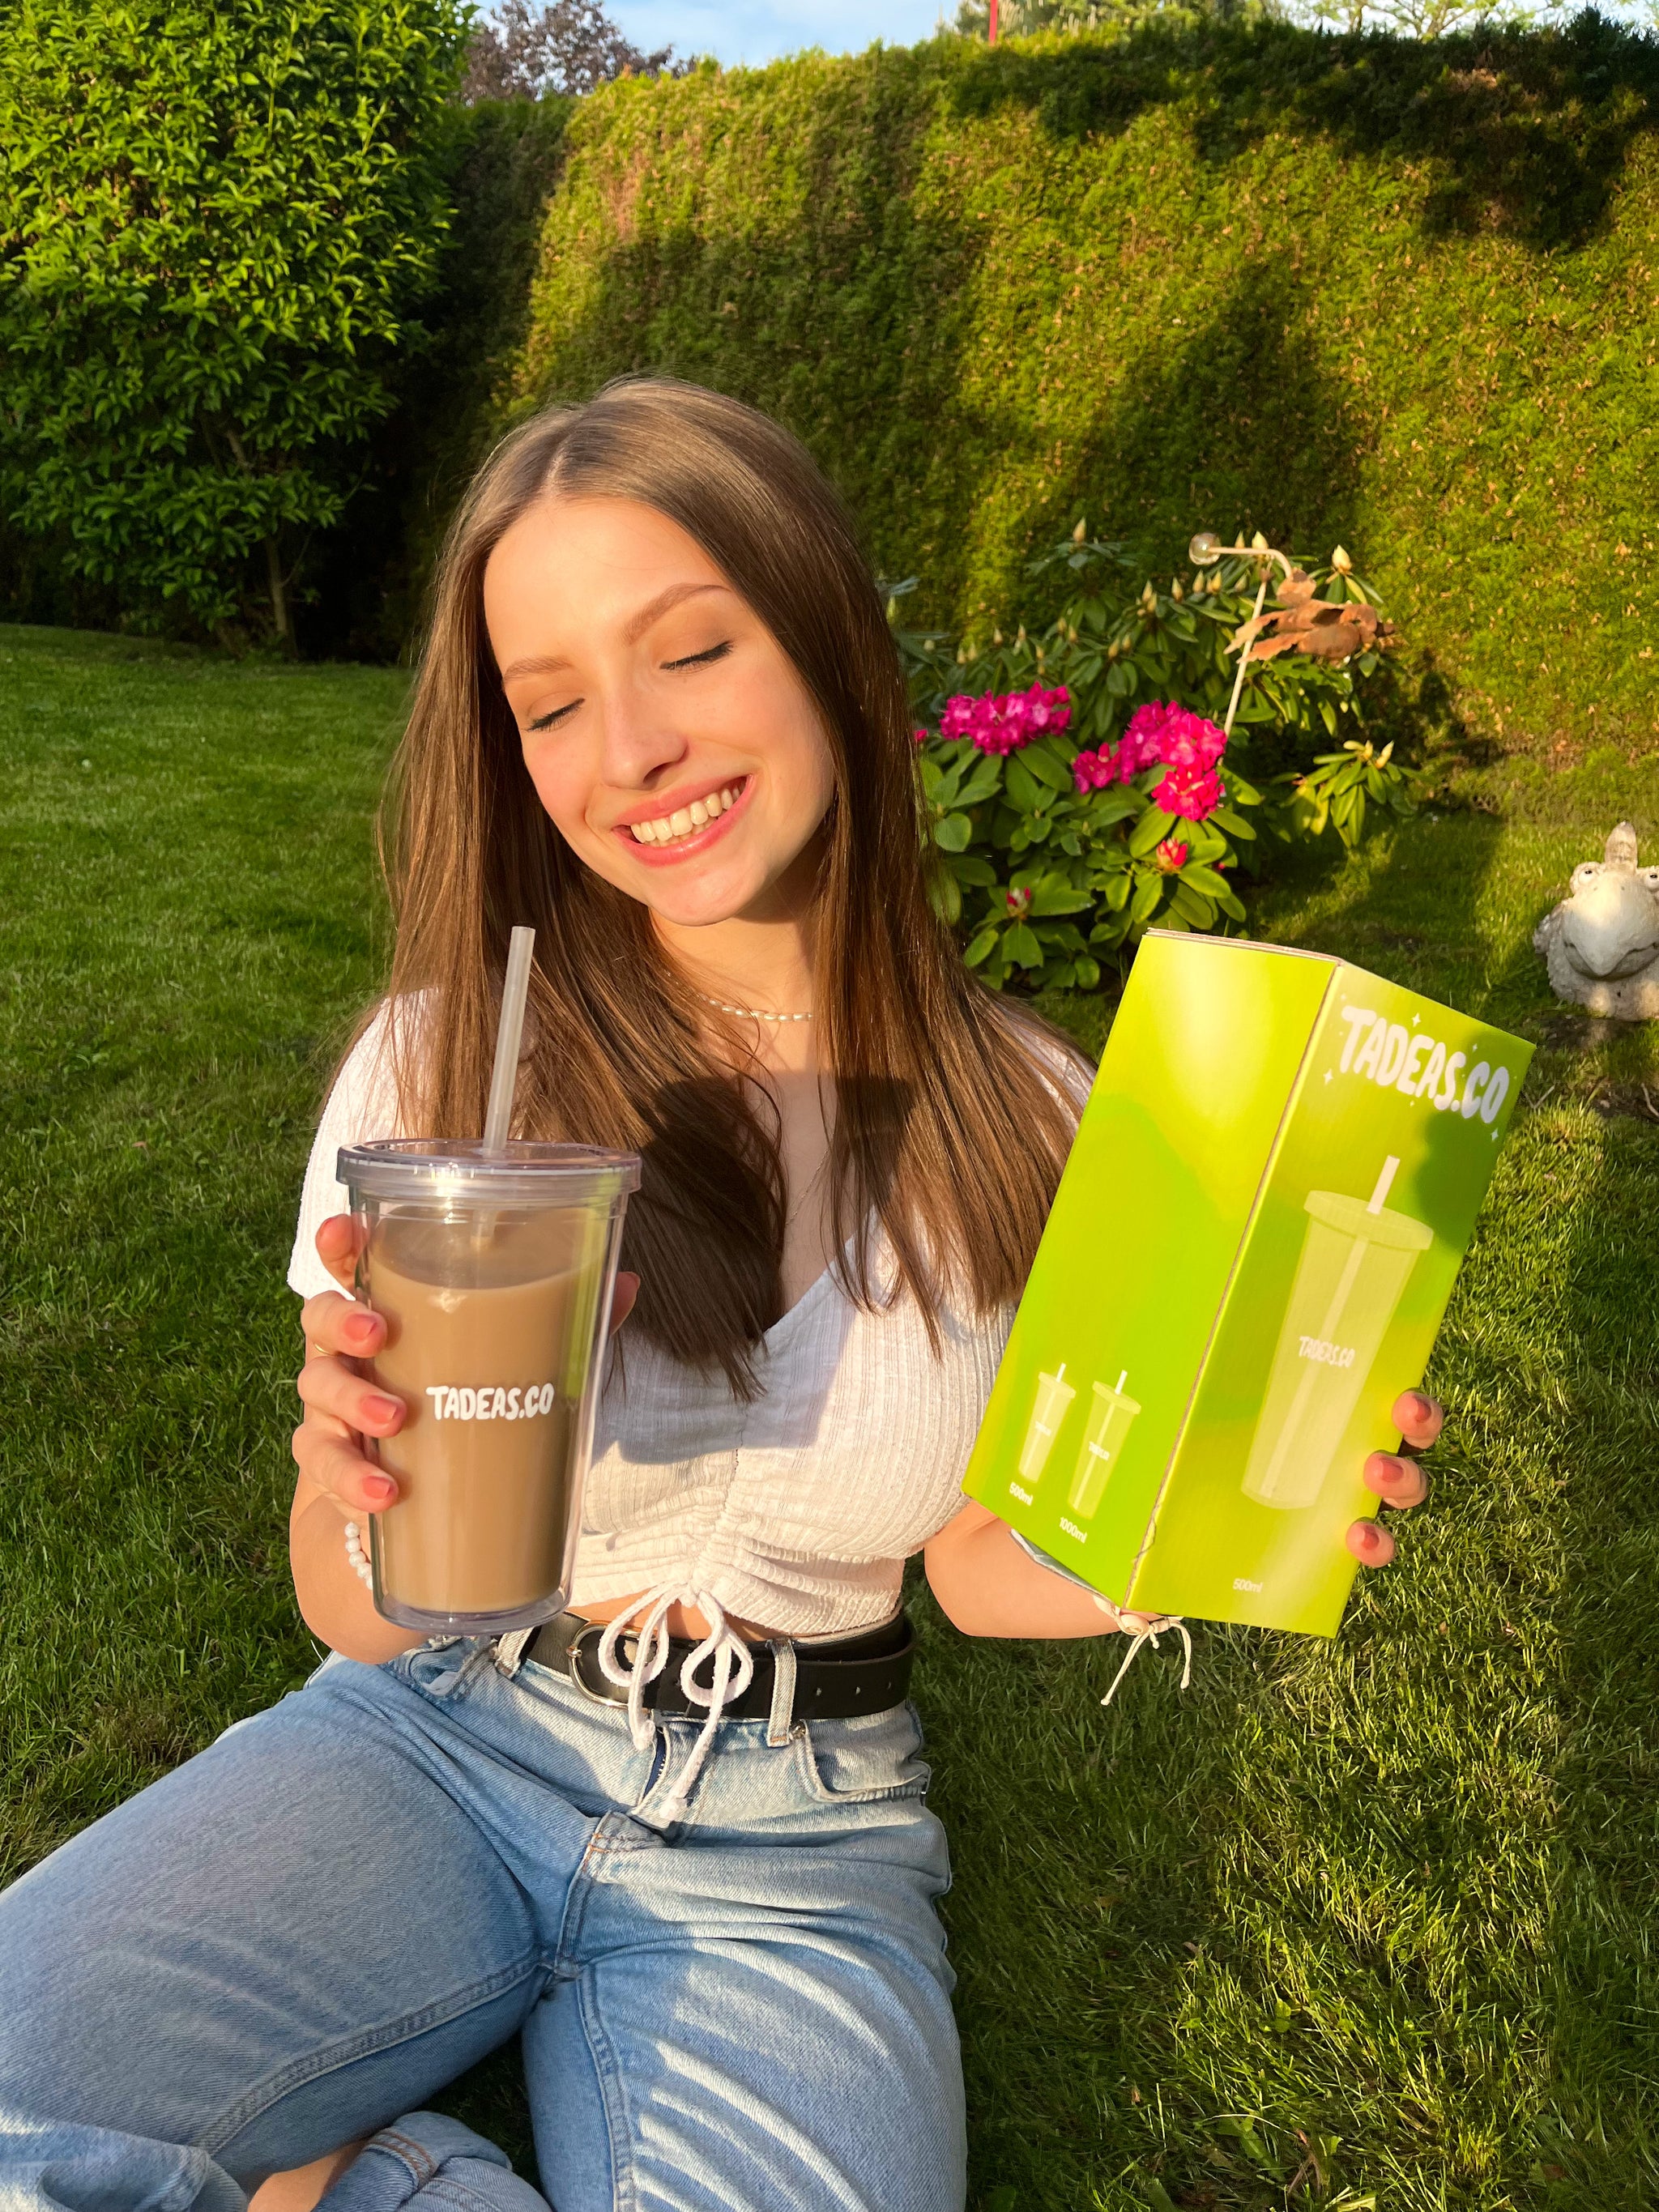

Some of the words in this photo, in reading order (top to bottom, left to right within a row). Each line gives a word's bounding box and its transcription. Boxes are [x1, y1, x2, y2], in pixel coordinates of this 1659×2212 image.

[1340, 1005, 1509, 1123] TADEAS.CO
[425, 1383, 555, 1421] TADEAS.CO
[1009, 1481, 1034, 1507] 500ml
[1060, 1516, 1087, 1544] 1000ml
[1233, 1578, 1263, 1593] 500ml
